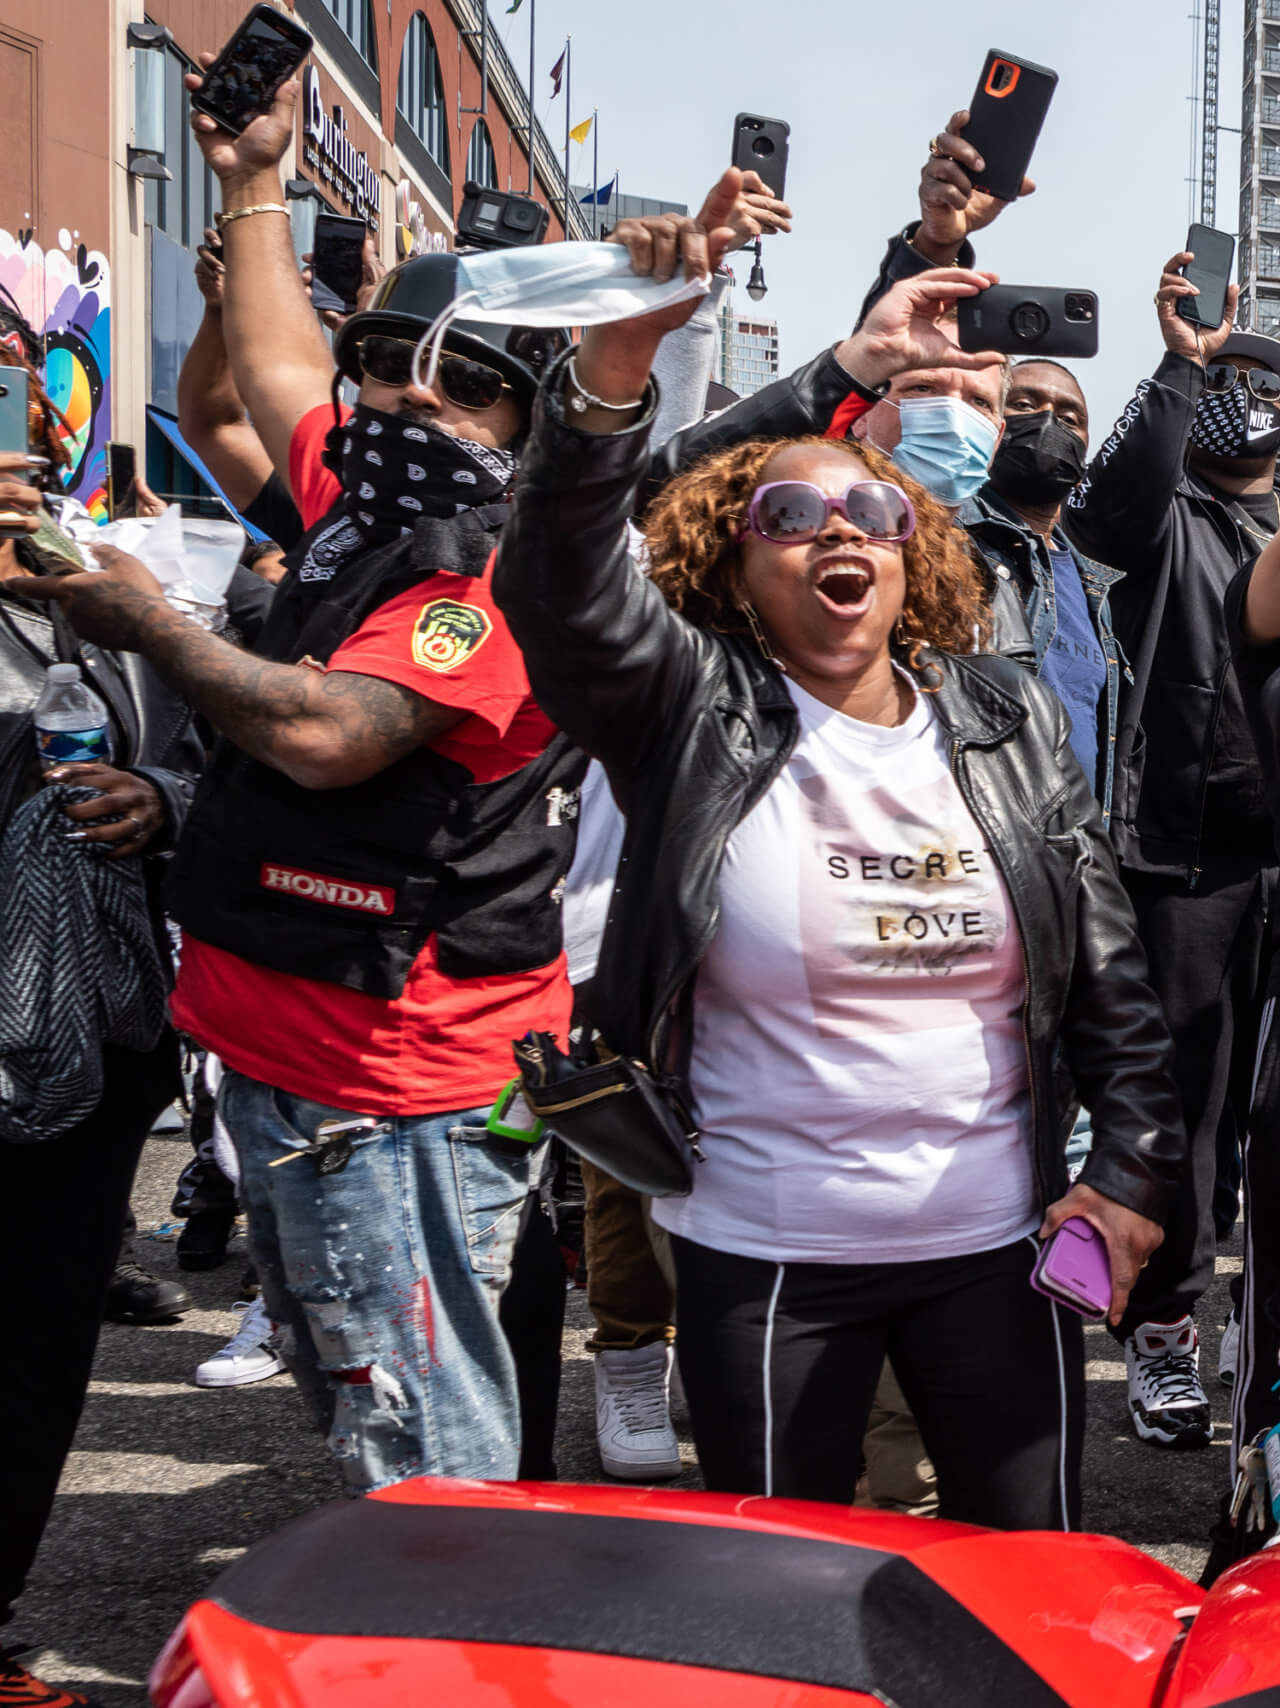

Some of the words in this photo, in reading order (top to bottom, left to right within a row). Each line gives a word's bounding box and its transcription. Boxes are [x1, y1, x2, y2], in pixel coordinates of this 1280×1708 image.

[304, 64, 381, 216] Burlington
[1249, 409, 1274, 431] NIKE
[1100, 434, 1121, 466] AIR
[828, 849, 992, 880] SECRE
[265, 867, 388, 912] HONDA
[876, 910, 984, 941] LOVE
